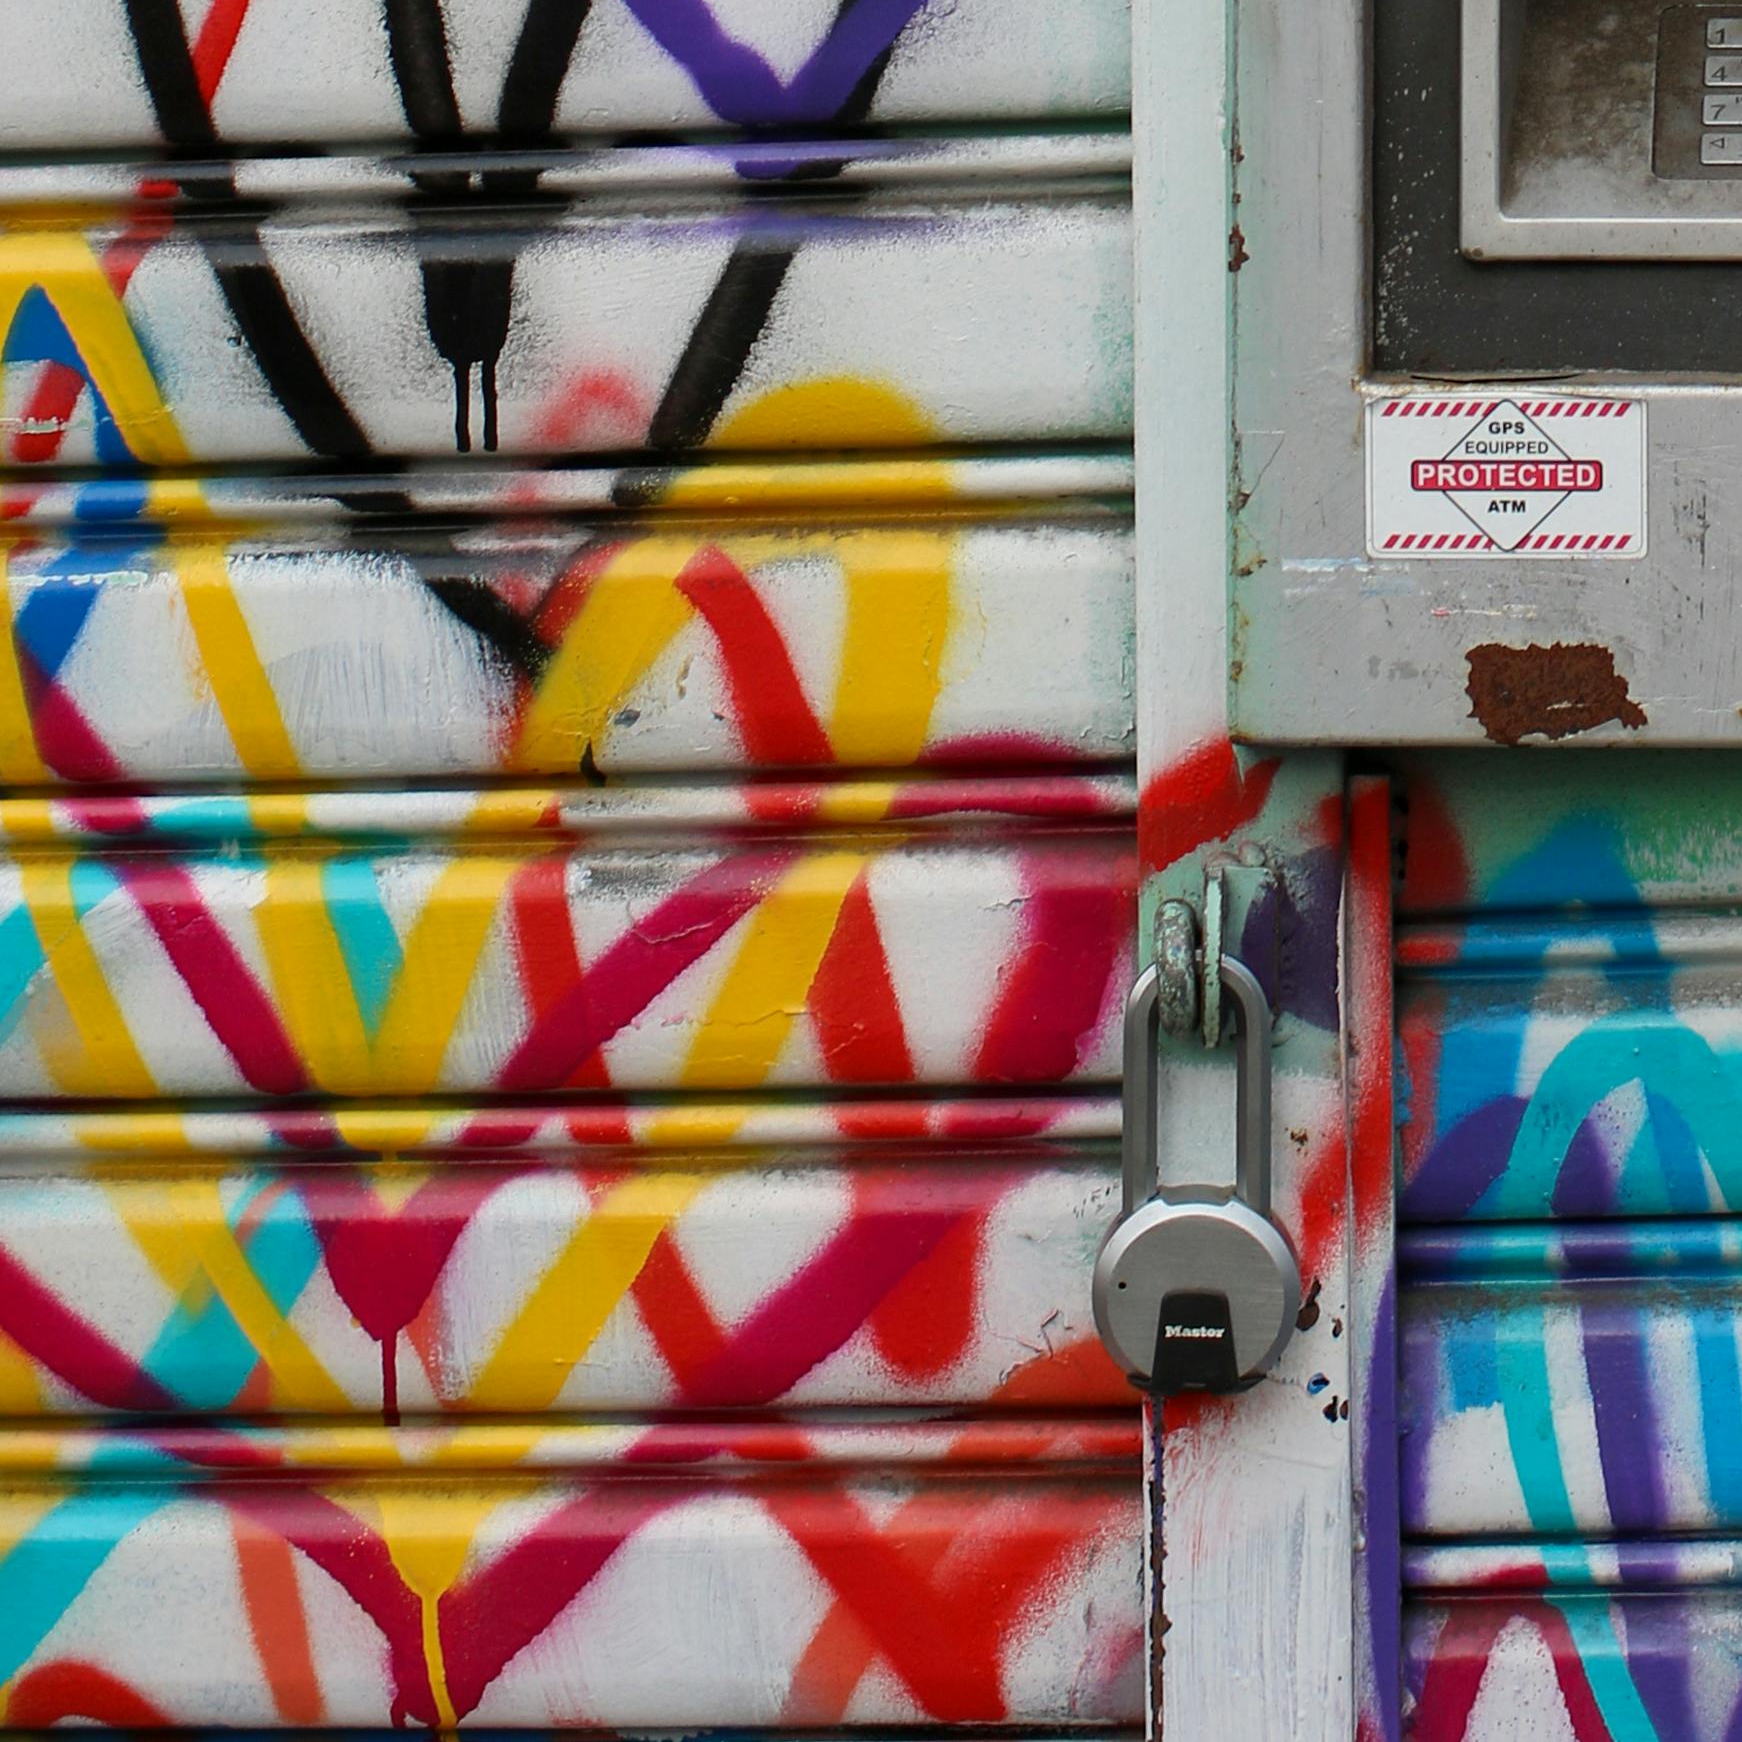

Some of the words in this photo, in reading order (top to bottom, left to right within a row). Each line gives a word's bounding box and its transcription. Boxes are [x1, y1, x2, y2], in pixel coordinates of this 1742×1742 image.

[1714, 29, 1726, 44] 1
[1711, 66, 1727, 82] 4
[1710, 104, 1726, 121] 7
[1488, 421, 1525, 435] GPS
[1465, 441, 1549, 456] EQUIPPED
[1417, 464, 1596, 488] PROTECTED
[1487, 500, 1526, 514] ATM
[1164, 1325, 1225, 1338] Master
